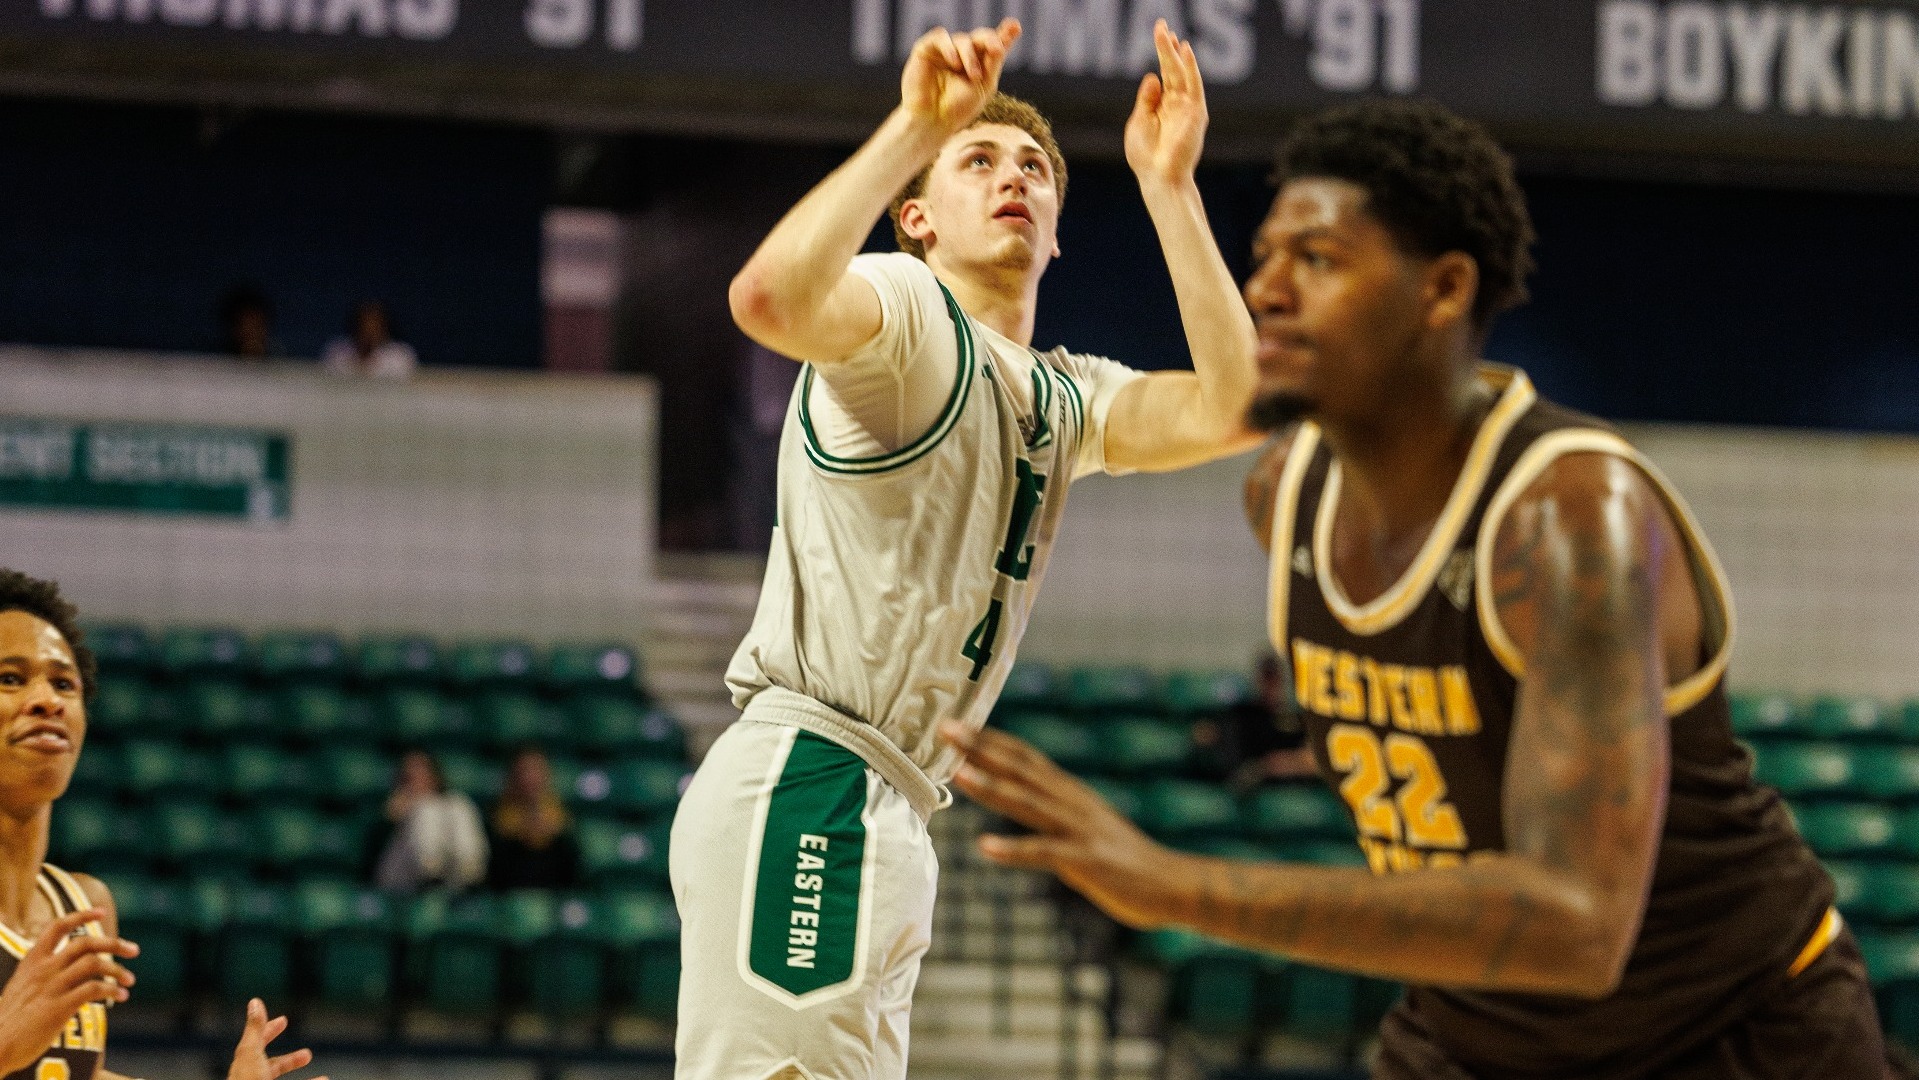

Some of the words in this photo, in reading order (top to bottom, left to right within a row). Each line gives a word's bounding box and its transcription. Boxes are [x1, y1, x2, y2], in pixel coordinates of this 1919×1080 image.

[961, 598, 1003, 682] 4
[1326, 722, 1468, 849] 22
[786, 833, 828, 969] EASTERN
